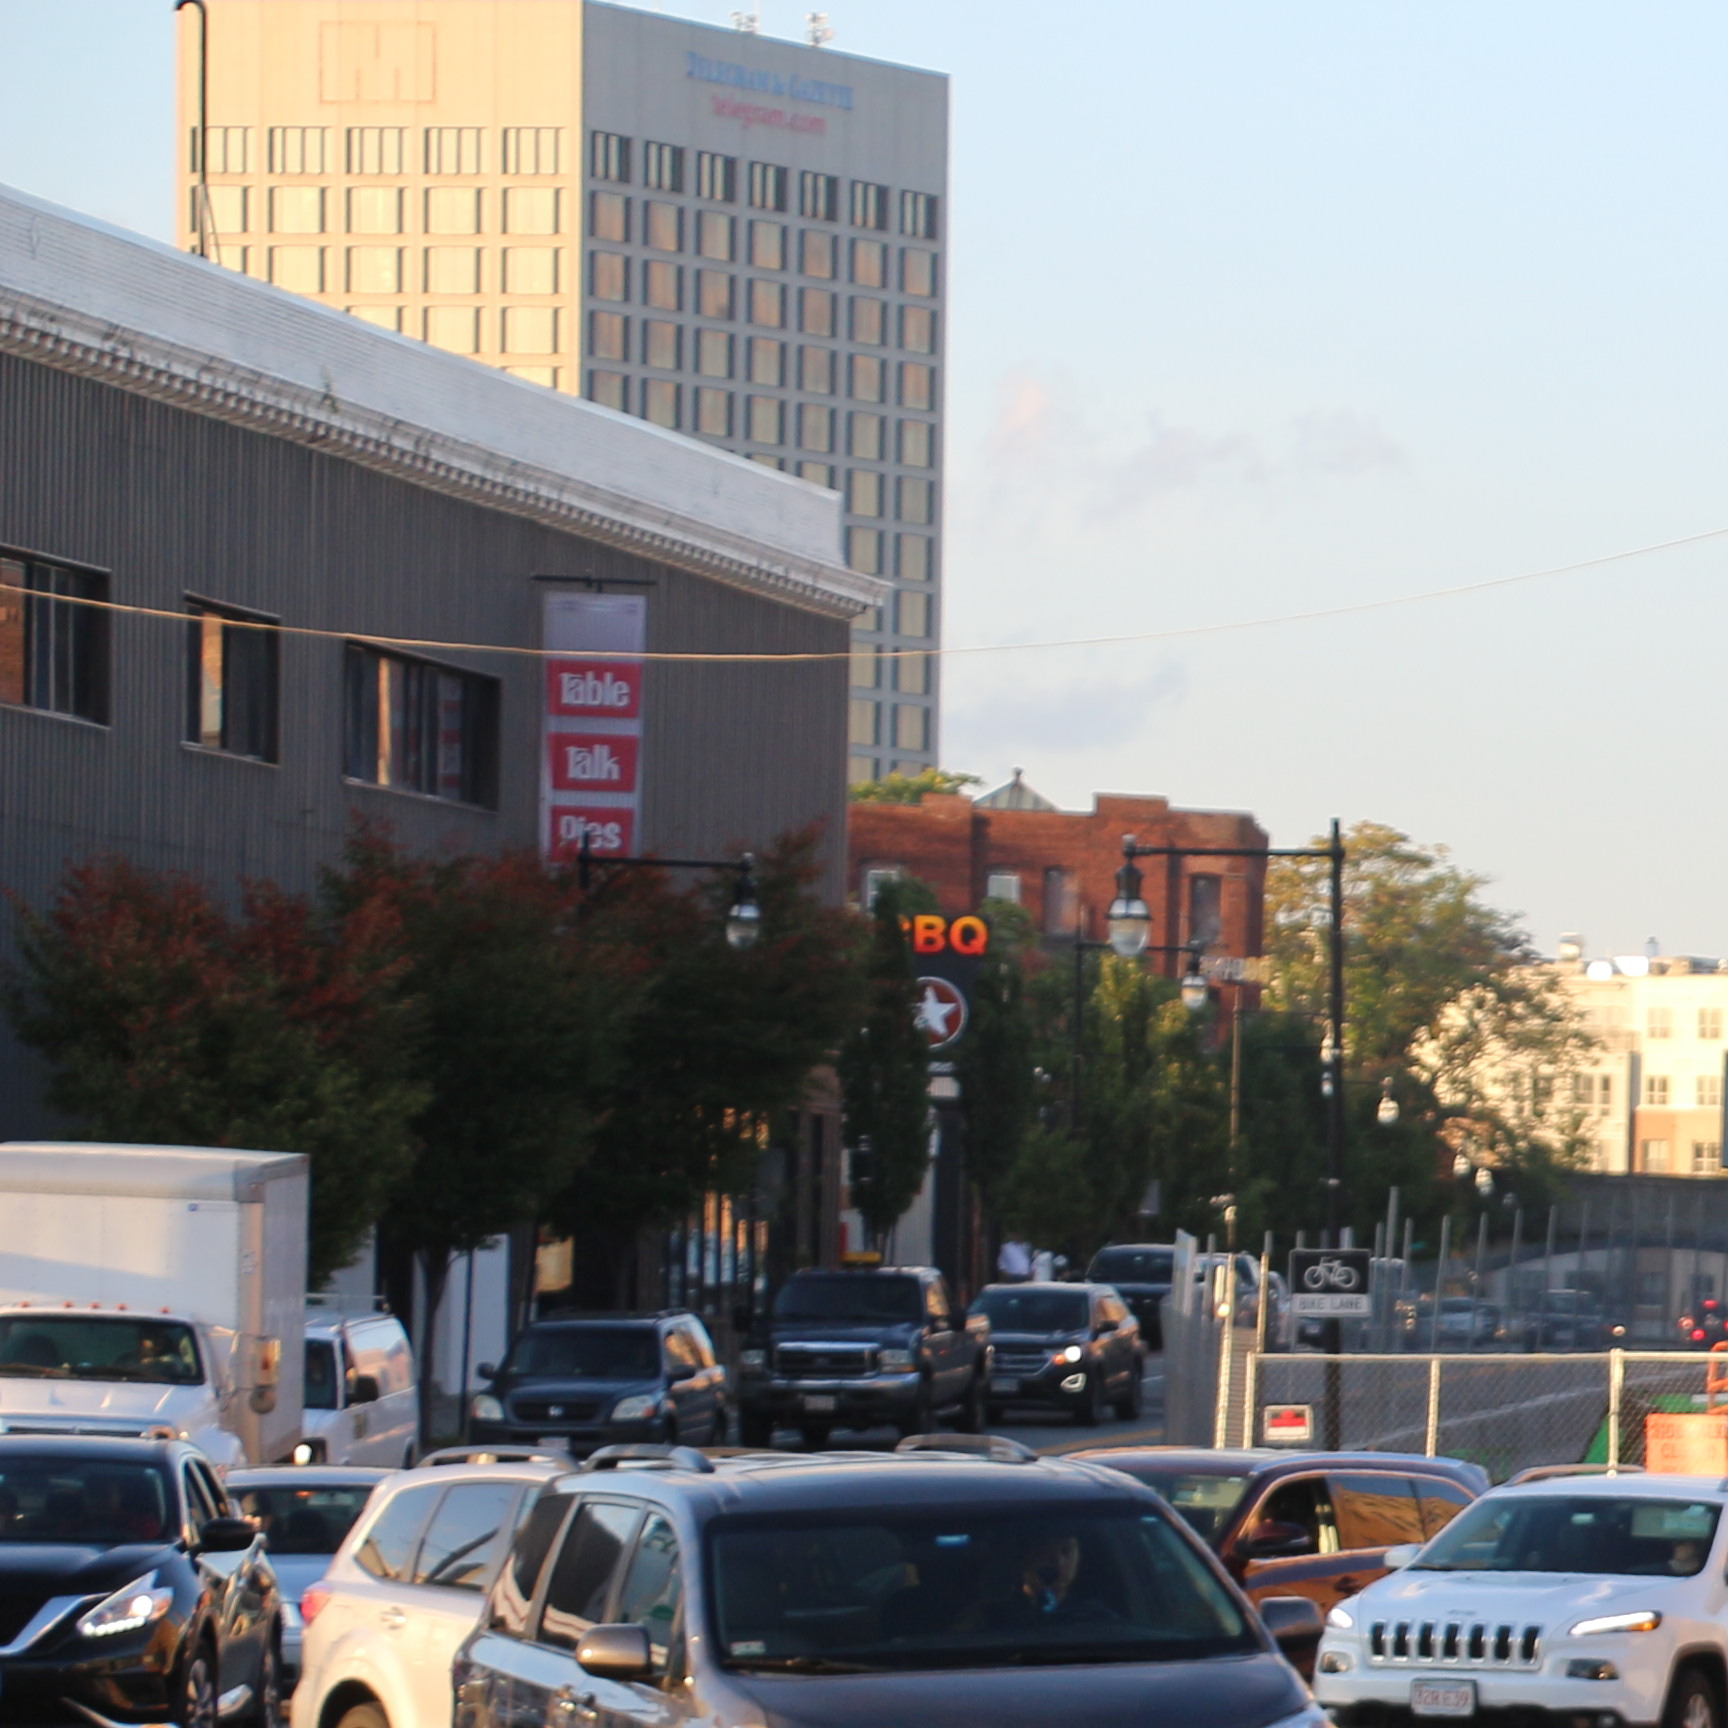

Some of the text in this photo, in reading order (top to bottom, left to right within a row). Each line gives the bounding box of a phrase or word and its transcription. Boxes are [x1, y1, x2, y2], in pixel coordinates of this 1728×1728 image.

[560, 671, 631, 707] Table
[566, 744, 621, 781] Talk
[899, 914, 989, 956] BQ
[1299, 1296, 1361, 1311] BIKE LANE
